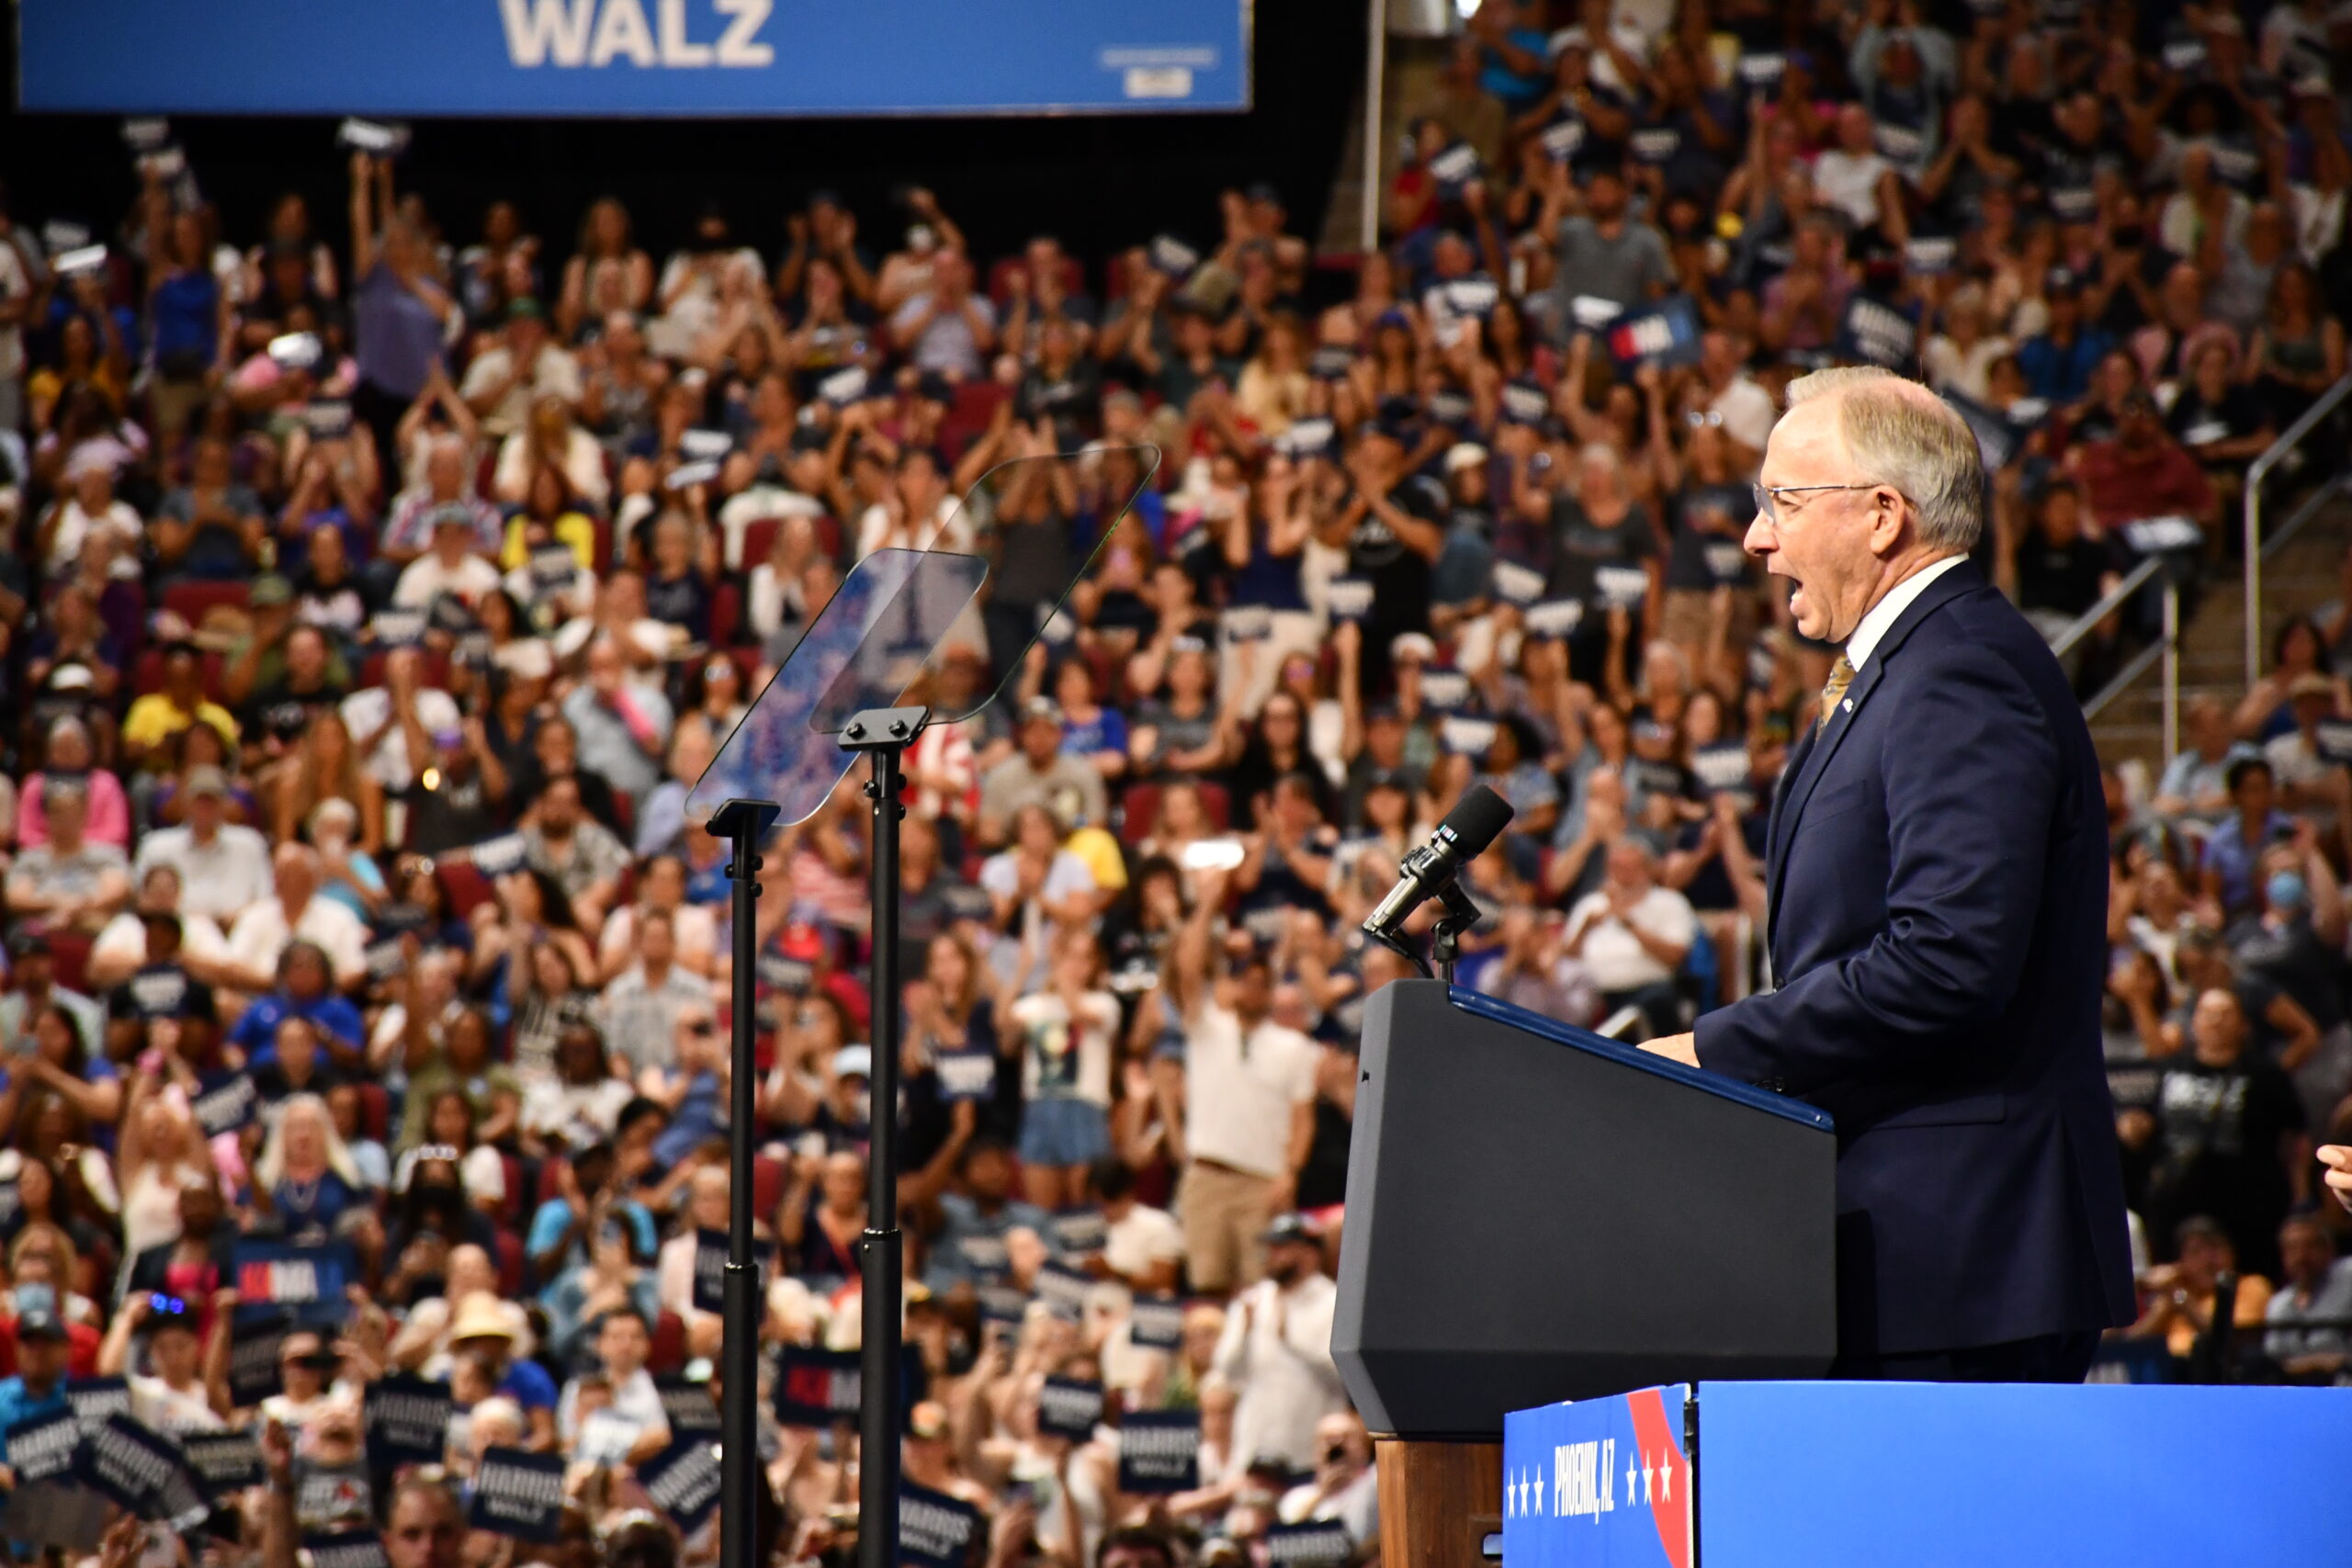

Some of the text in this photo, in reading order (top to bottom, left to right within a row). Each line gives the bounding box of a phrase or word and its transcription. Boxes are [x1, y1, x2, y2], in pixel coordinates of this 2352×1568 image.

[500, 0, 774, 67] WALZ
[1122, 1427, 1200, 1455] HARRIS
[481, 1461, 563, 1504] HARRIS
[1555, 1438, 1615, 1525] PHOENIX, AZ
